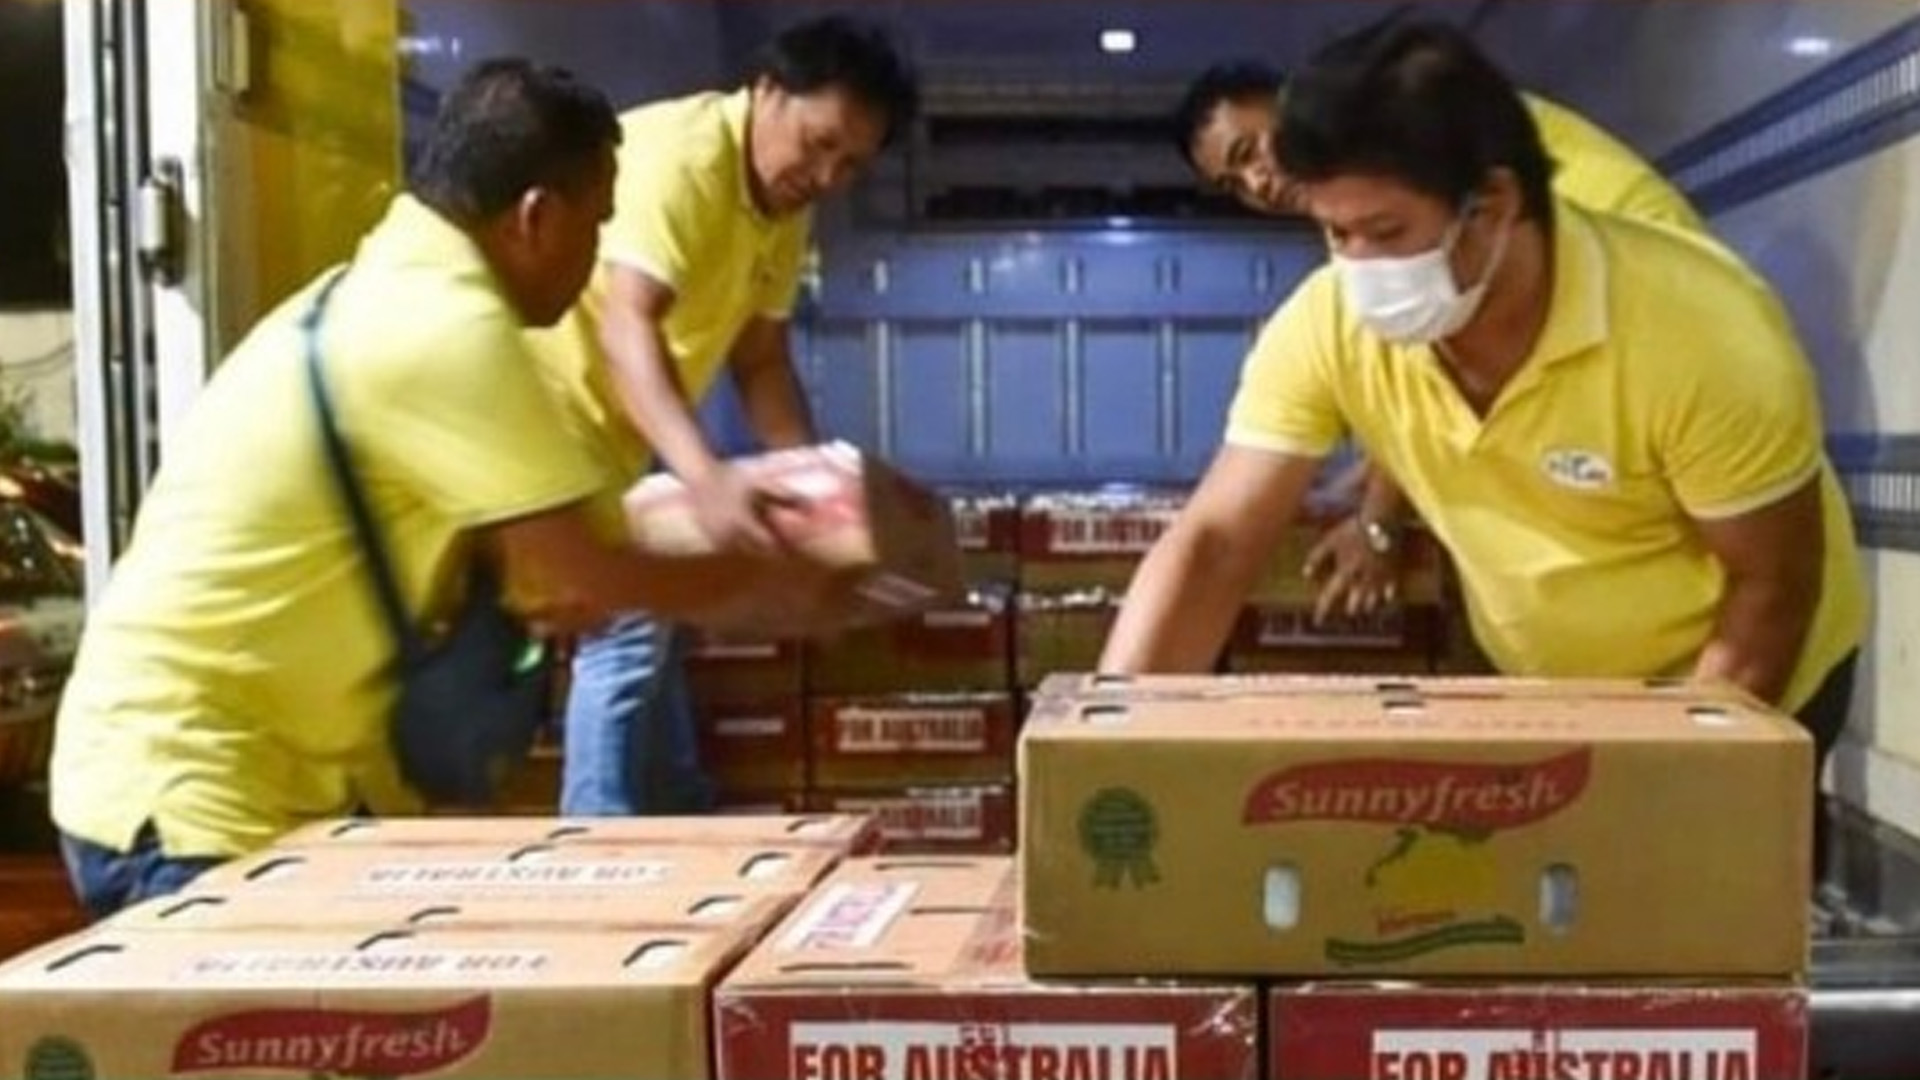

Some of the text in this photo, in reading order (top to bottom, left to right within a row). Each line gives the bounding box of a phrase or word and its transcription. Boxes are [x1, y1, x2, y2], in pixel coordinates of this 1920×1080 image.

[1270, 771, 1558, 821] Sunnyfresh
[197, 1018, 467, 1068] Sunnyfresh
[795, 1044, 885, 1079] FOR
[1375, 1050, 1468, 1079] FOR
